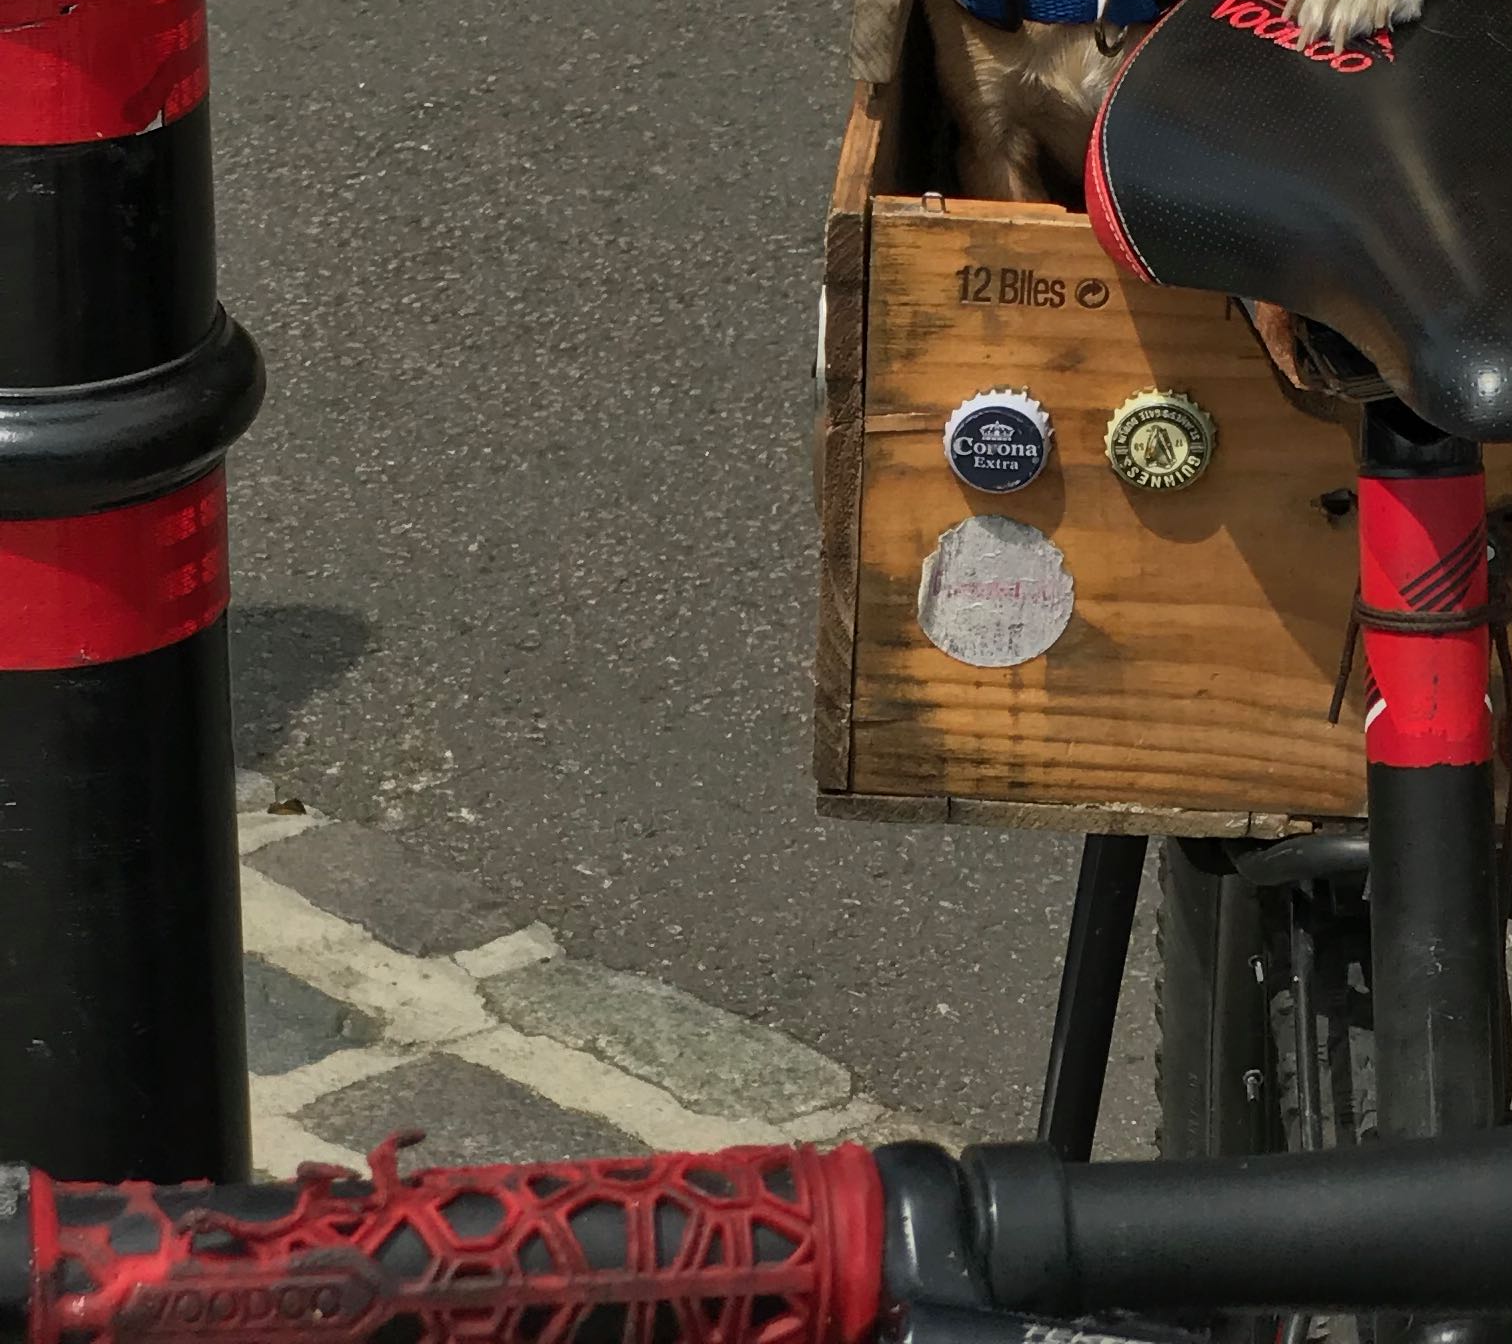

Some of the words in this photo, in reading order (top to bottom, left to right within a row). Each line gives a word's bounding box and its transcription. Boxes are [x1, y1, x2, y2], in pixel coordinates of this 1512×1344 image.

[955, 265, 992, 303] 12
[953, 436, 1038, 457] Corona
[973, 456, 1019, 470] Extra
[1119, 455, 1202, 489] GUINNESS
